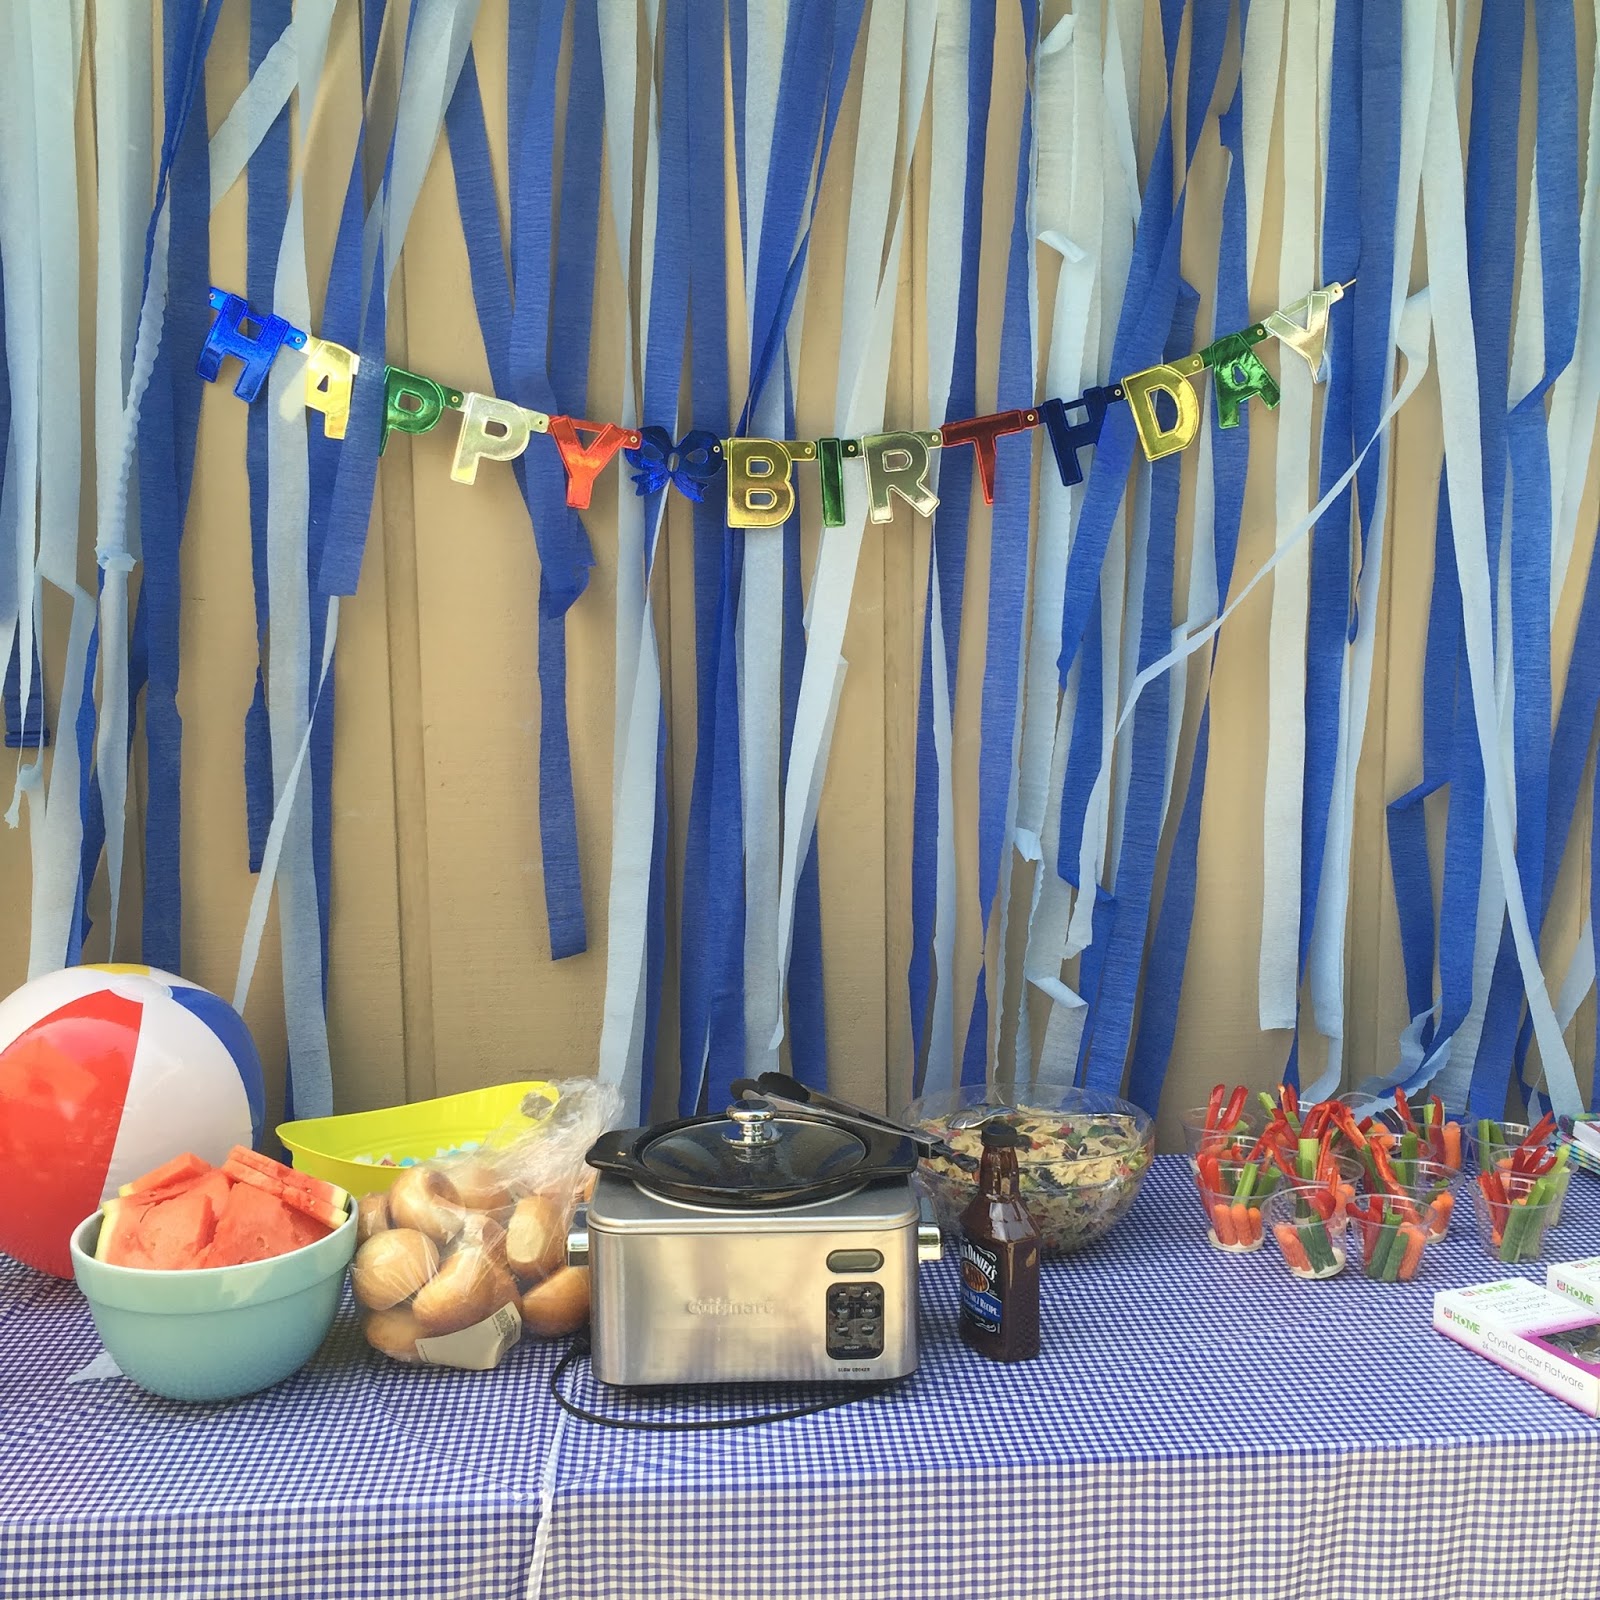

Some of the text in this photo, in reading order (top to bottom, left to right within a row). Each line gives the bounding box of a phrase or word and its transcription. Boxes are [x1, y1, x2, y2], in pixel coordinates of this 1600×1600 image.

[196, 288, 1331, 528] HAPPY BIRTHDAY
[1566, 1284, 1594, 1306] HOME
[1453, 1312, 1480, 1335] HOME
[1487, 1331, 1516, 1354] Crystal
[1518, 1348, 1543, 1367] Clear
[1544, 1361, 1585, 1391] Flatware
